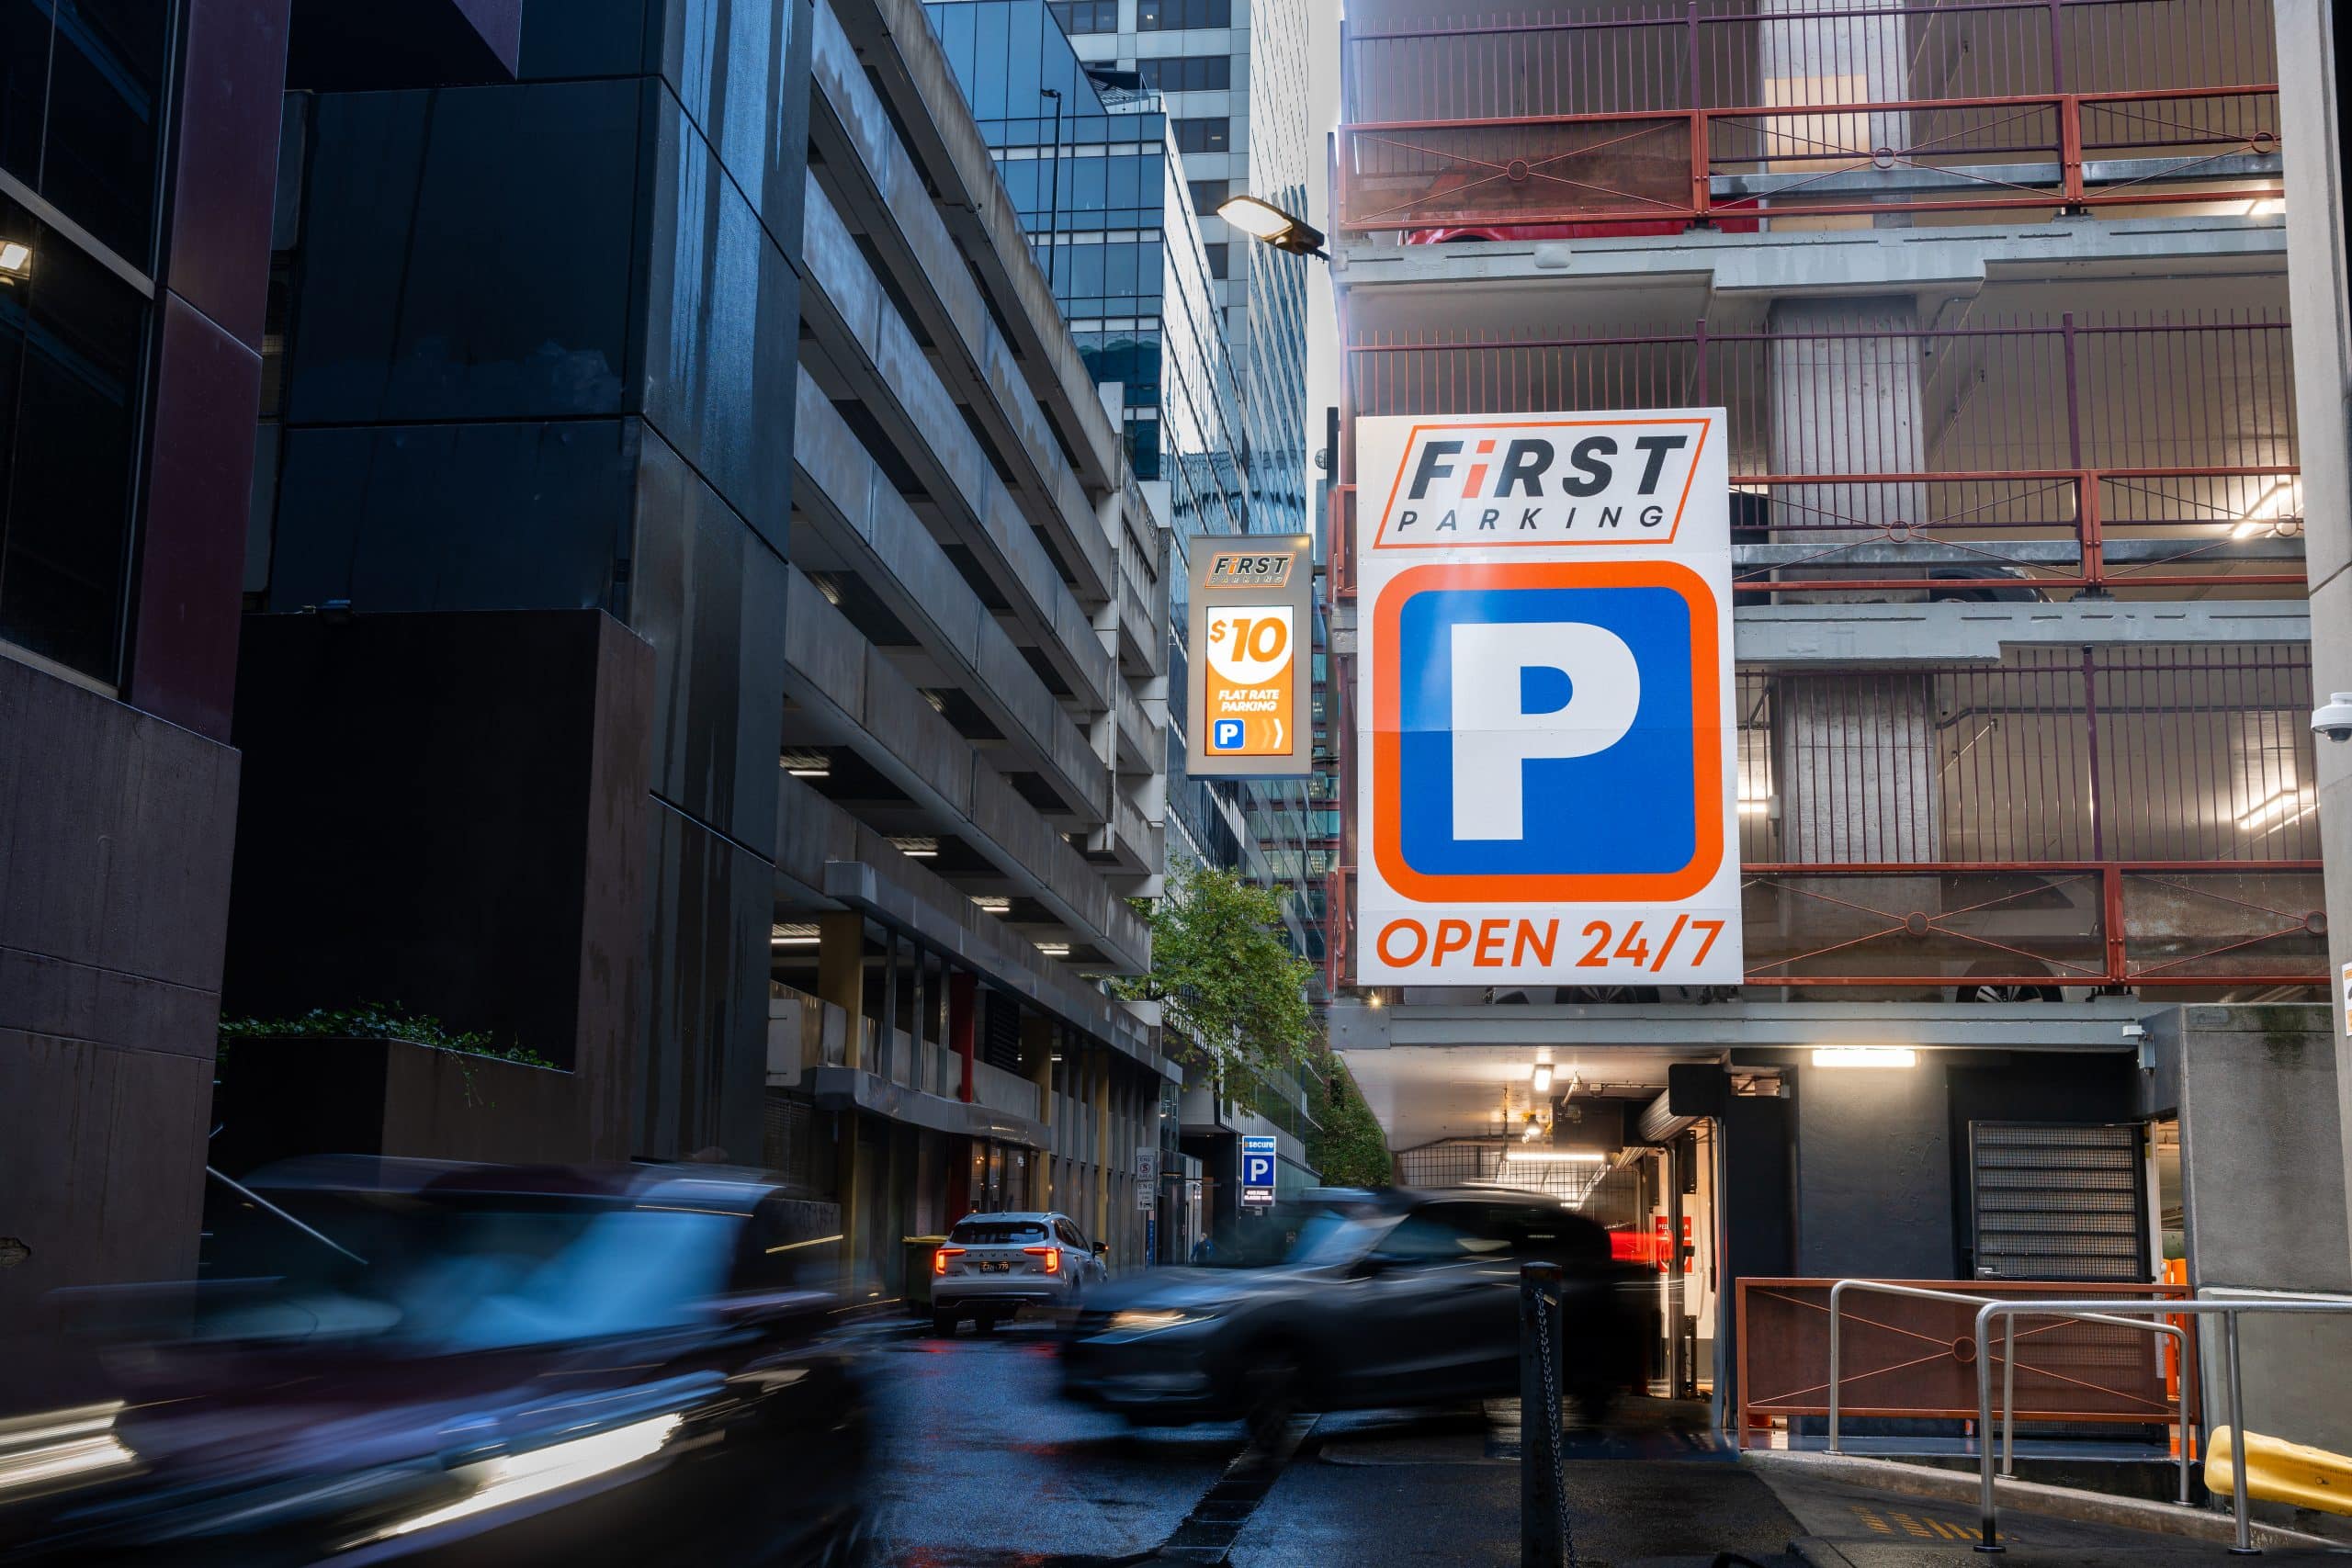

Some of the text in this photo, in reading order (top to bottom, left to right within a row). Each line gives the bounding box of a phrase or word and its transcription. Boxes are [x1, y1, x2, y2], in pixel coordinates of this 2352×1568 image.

[1397, 505, 1664, 532] PARKING
[1210, 616, 1288, 662] $10
[1218, 689, 1280, 700] FLAT RATE
[1221, 701, 1277, 712] PARKING
[1219, 724, 1238, 744] P
[1451, 622, 1641, 840] P
[1376, 914, 1725, 973] OPEN 24/7
[1250, 1159, 1269, 1181] P
